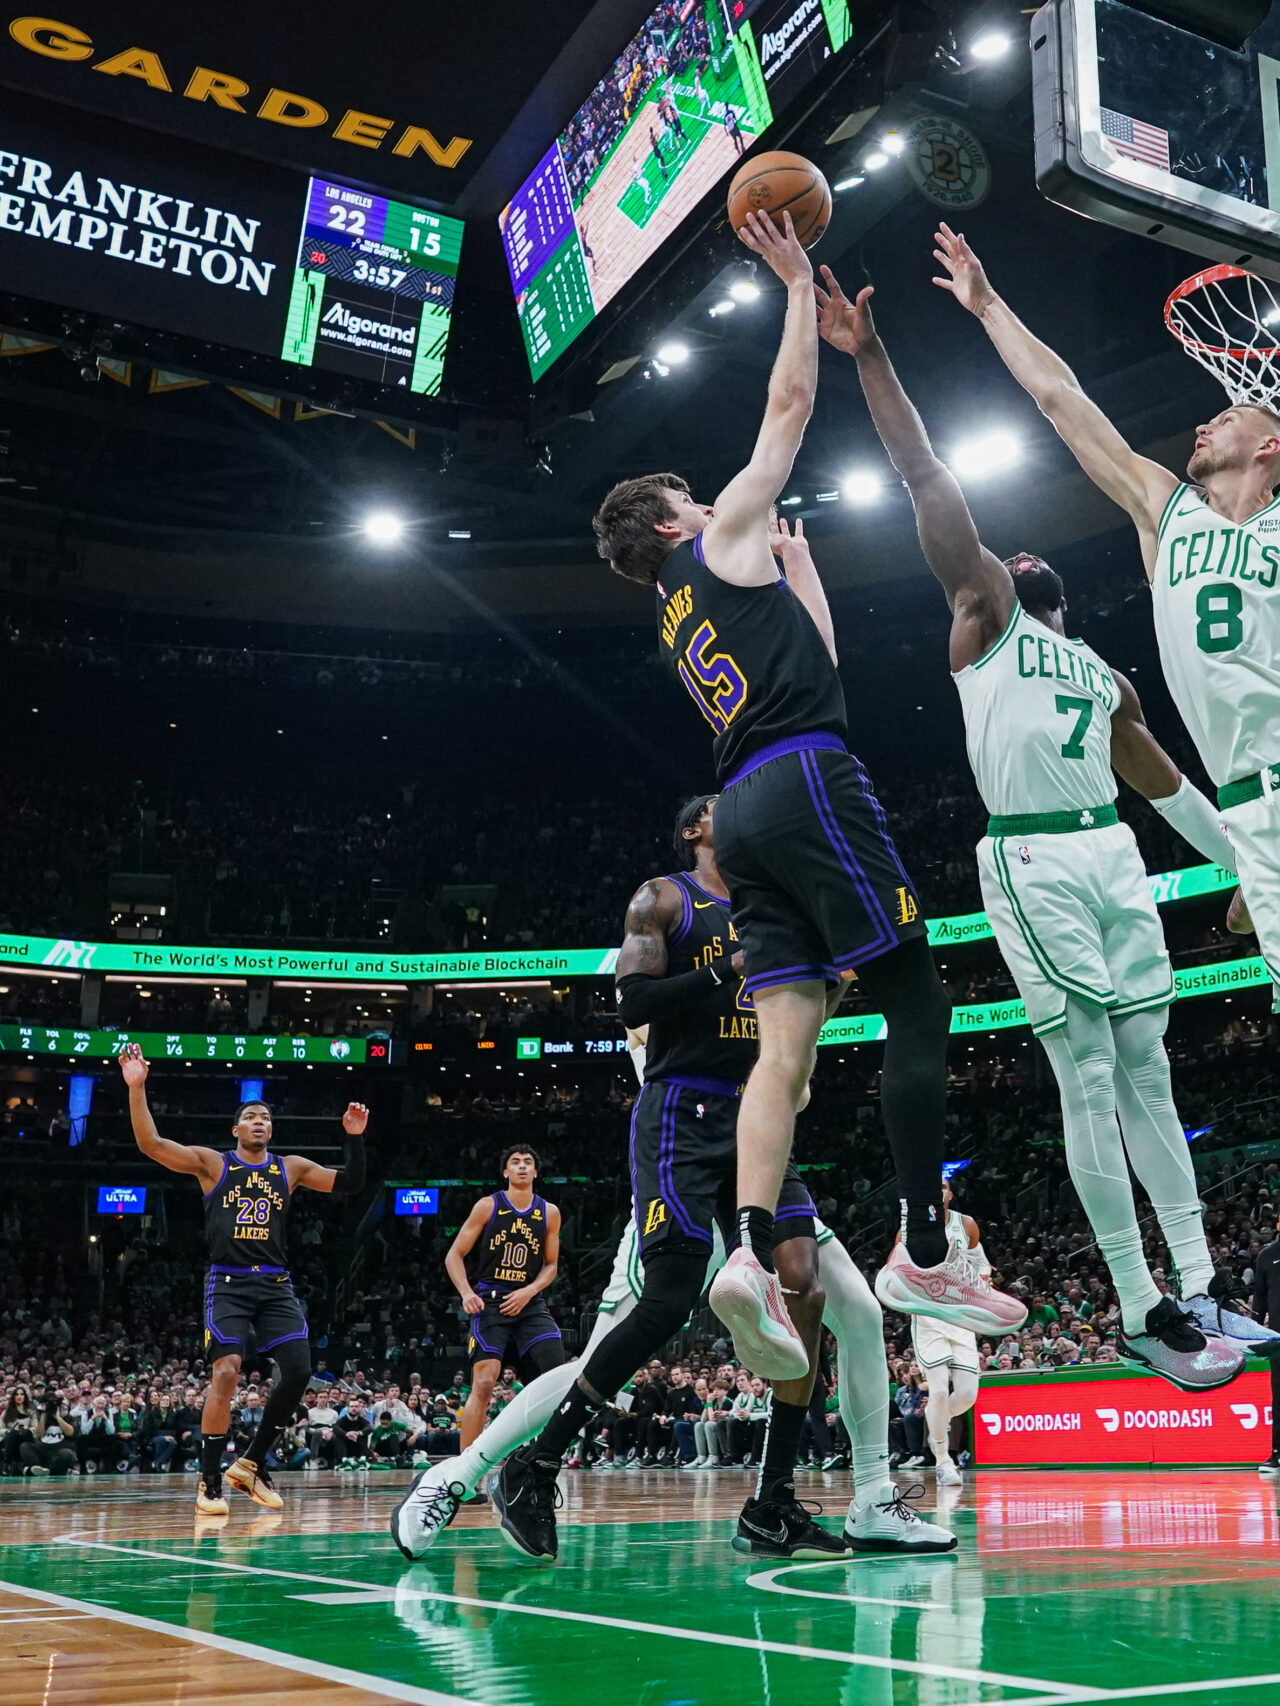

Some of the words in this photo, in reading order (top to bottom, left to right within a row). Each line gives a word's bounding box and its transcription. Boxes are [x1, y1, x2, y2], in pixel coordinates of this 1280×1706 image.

[8, 16, 474, 169] GARDEN
[936, 149, 955, 175] 2
[0, 151, 262, 253] FRANKLIN
[325, 186, 340, 200] LOS
[340, 189, 373, 209] ANGELES
[327, 205, 366, 236] 22
[412, 212, 440, 228] BOSTON
[409, 227, 441, 257] 15
[310, 251, 327, 265] 20
[353, 260, 407, 289] 3:57
[322, 302, 416, 344] Algorand
[320, 327, 412, 358] www.algorand.com
[1170, 528, 1280, 588] CELTICS
[662, 584, 693, 650] REAVES
[1196, 582, 1243, 654] 8
[678, 619, 748, 736] 15
[1018, 634, 1114, 712] CELTICS
[1055, 694, 1093, 760] 7
[133, 951, 163, 965] The
[169, 953, 228, 968] World's
[234, 955, 273, 969] Most
[278, 957, 348, 972] Powerful
[355, 960, 383, 972] and
[390, 959, 480, 973] Sustainable
[485, 956, 568, 971] Blockchain
[1175, 965, 1261, 991] Sustainable
[719, 1016, 760, 1040] LAKE
[957, 1013, 984, 1025] The
[20, 1028, 32, 1036] FLS
[46, 1030, 60, 1038] TOL
[263, 1038, 277, 1046] AST
[22, 1038, 30, 1049] 2
[48, 1040, 56, 1050] 6
[73, 1042, 89, 1053] 47
[166, 1044, 183, 1056] 1/6
[207, 1045, 215, 1056] 5
[236, 1047, 244, 1057] 0
[266, 1047, 274, 1058] 6
[293, 1048, 306, 1059] 10
[519, 1041, 538, 1055] TD
[544, 1042, 573, 1053] Bank
[585, 1040, 613, 1053] 7:59
[370, 1046, 385, 1057] 20
[106, 1194, 138, 1203] ULTRA
[223, 1185, 241, 1208] LOS
[246, 1172, 283, 1210] ANGELES
[402, 1195, 431, 1204] ULTRA
[236, 1197, 271, 1225] 28
[233, 1226, 270, 1241] LAKERS
[490, 1230, 507, 1251] LOS
[511, 1217, 541, 1255] ANGELES
[502, 1242, 528, 1269] 10
[494, 1267, 527, 1283] LAKERS
[1005, 1413, 1081, 1432] DOORDASH
[1124, 1408, 1213, 1430] DOORDASH
